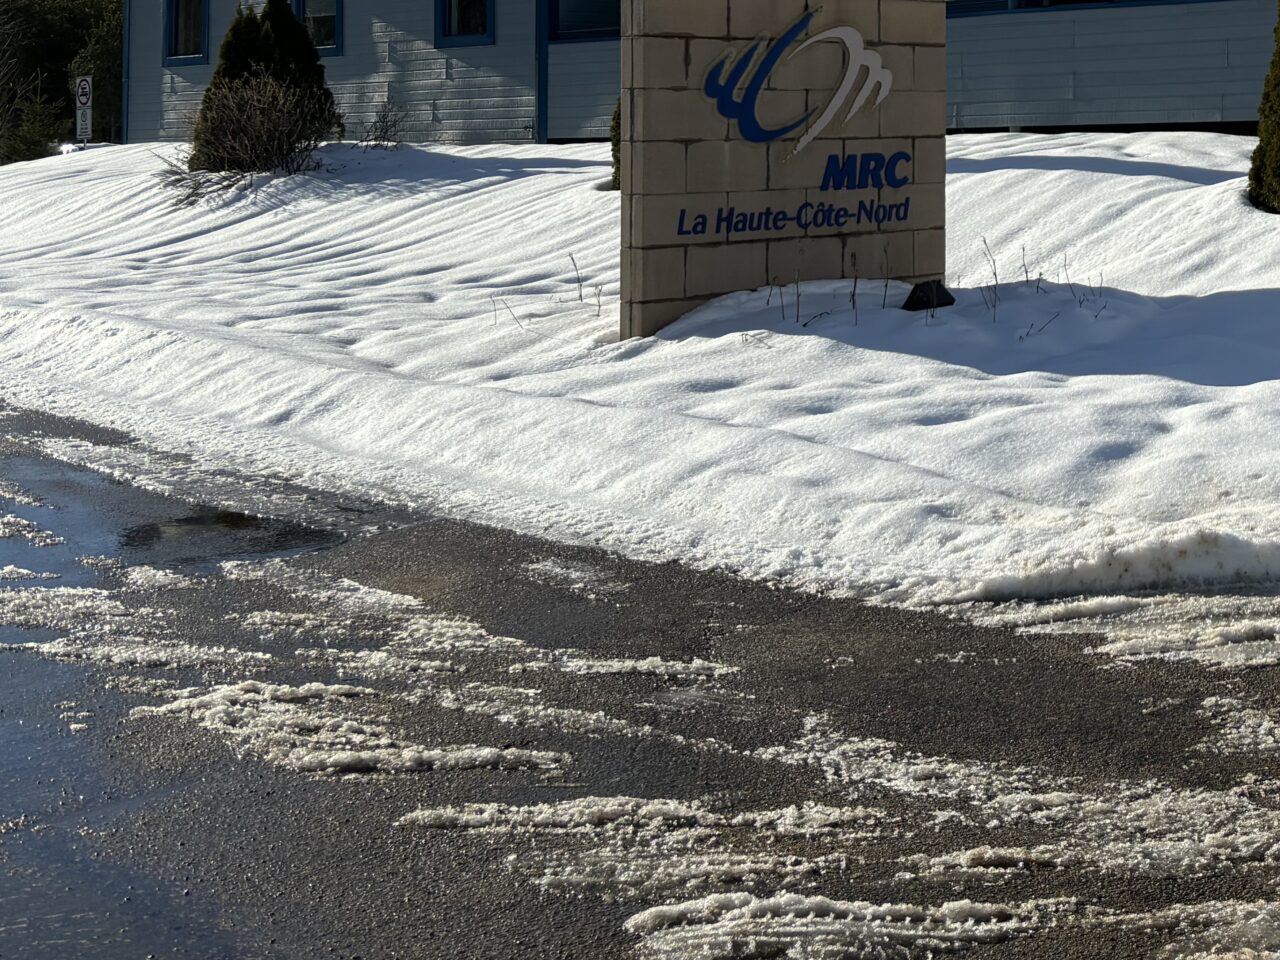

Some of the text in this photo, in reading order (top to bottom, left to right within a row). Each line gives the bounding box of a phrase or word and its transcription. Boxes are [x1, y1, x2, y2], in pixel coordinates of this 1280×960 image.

[820, 151, 912, 192] MRC
[677, 197, 910, 236] La Haute-Côte-Nord
